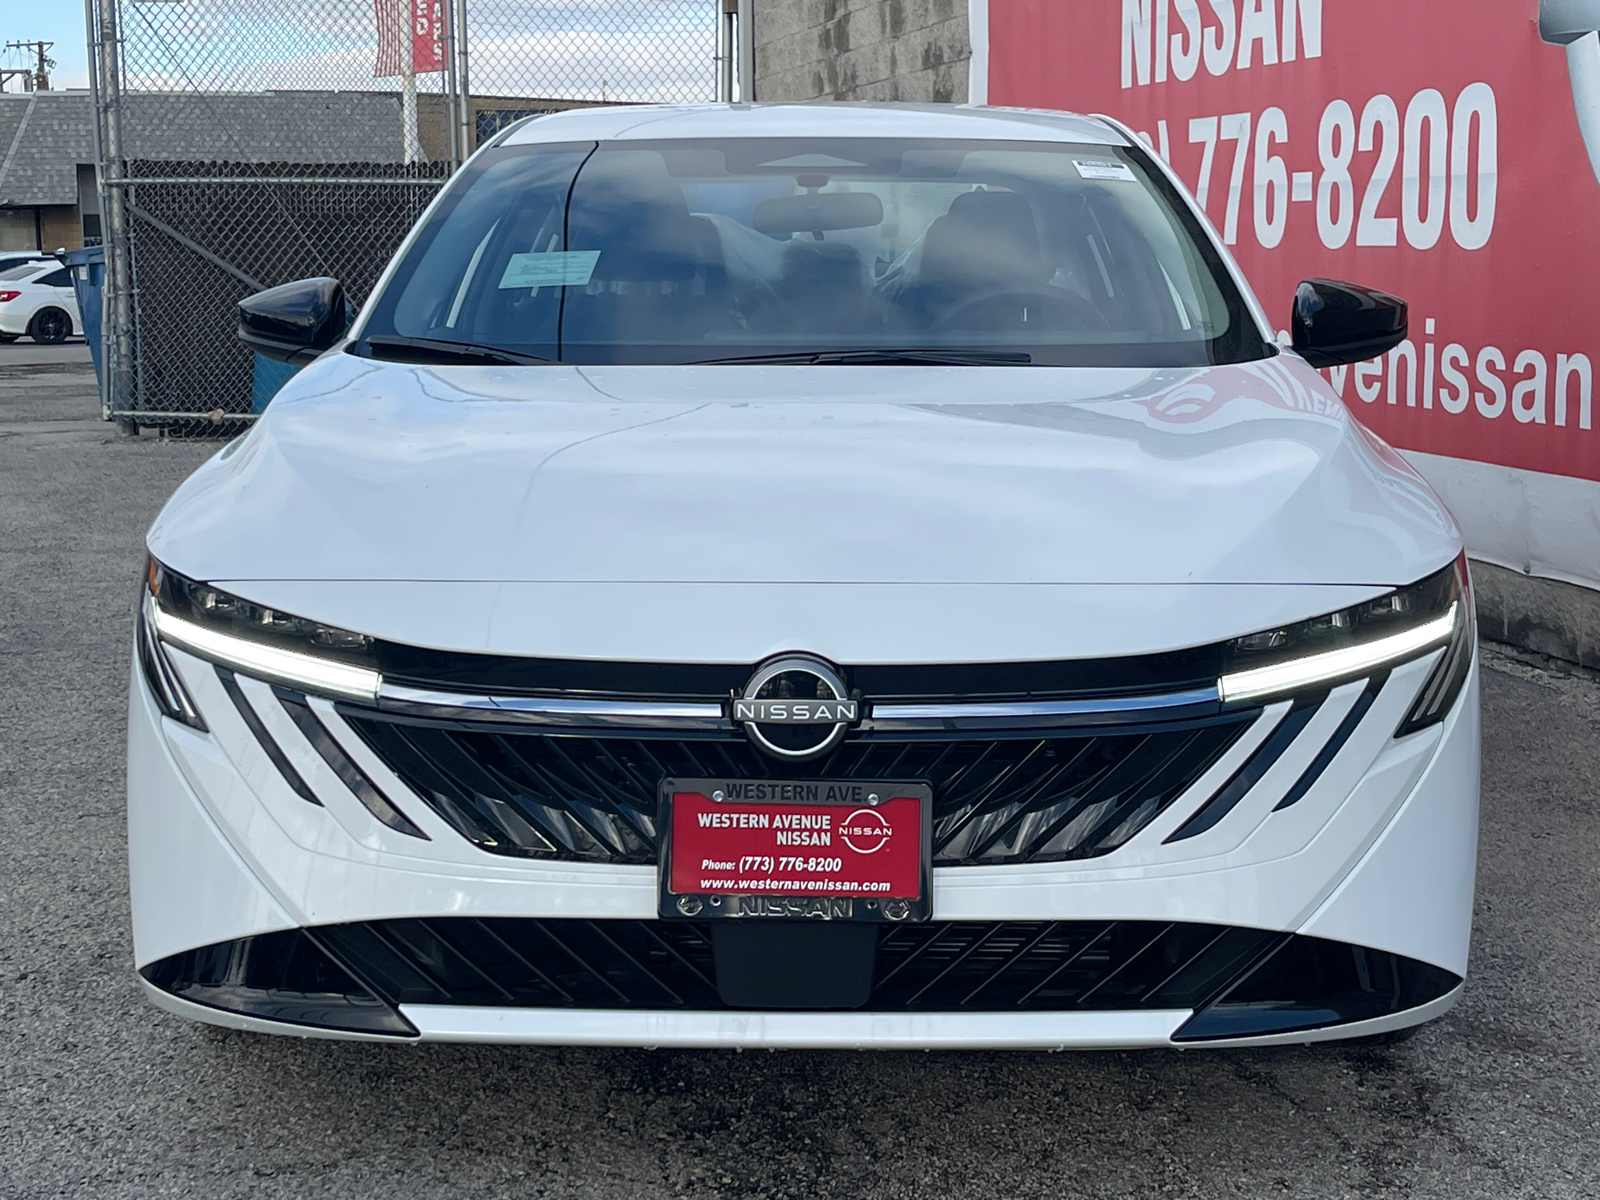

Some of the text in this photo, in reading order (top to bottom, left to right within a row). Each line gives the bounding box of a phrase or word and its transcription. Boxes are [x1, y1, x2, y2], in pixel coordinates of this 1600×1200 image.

[1188, 82, 1498, 250] 776-8200
[736, 703, 855, 720] NISSAN
[726, 783, 819, 801] WESTERN
[697, 813, 831, 829] WESTERN AVENUE
[777, 831, 831, 846] NISSAN
[838, 827, 892, 836] NISSAN
[701, 856, 842, 874] Phone: (773) 776-8200
[700, 878, 891, 892] www.westernavenissan.com
[737, 896, 853, 918] NISSAN
